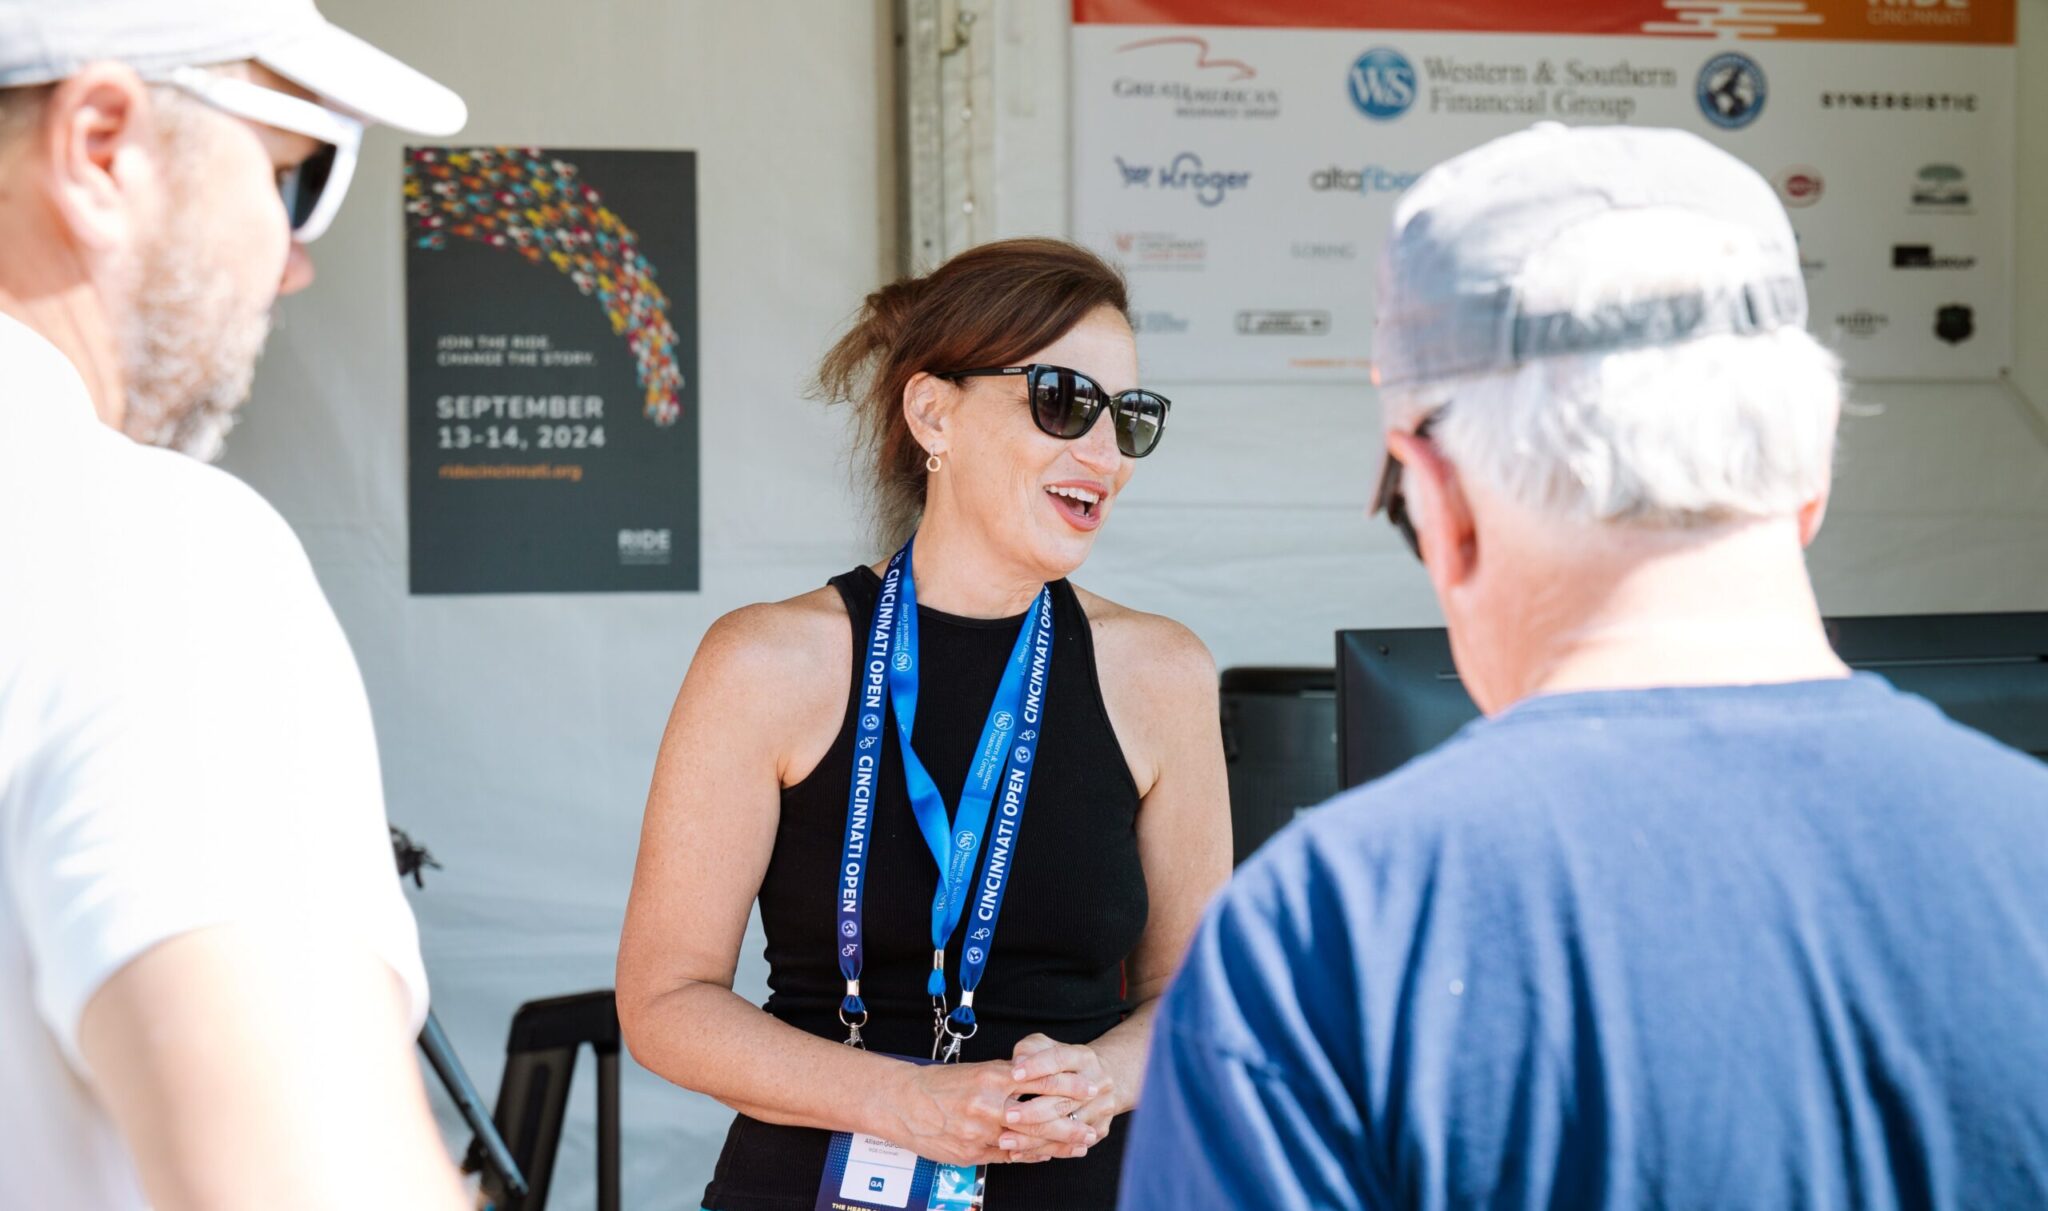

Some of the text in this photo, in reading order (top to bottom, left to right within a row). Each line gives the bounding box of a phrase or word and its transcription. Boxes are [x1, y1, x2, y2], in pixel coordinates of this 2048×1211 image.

[1423, 56, 1678, 87] Western & Southern
[1428, 89, 1637, 118] Financial Group
[1821, 91, 1978, 111] SYNERGISTIC
[1158, 151, 1252, 207] Kroger
[437, 335, 554, 349] JOIN THE RIDE.
[437, 352, 597, 366] CHANGE THE STORY.
[437, 395, 603, 419] SEPTEMBER
[438, 425, 606, 451] 13-14, 2024
[438, 463, 583, 482] ridecincinnati.org
[617, 528, 671, 550] RIDE
[865, 569, 900, 708] CINCINNATI OPEN
[1024, 629, 1050, 724] CINCINNATI
[976, 729, 999, 778] Financial Group
[993, 731, 1007, 755] Western
[981, 763, 996, 790] Southern
[842, 755, 874, 913] CINCINNATI OPEN
[978, 768, 1026, 921] CINCINNATI OPEN
[832, 1203, 846, 1211] THE
